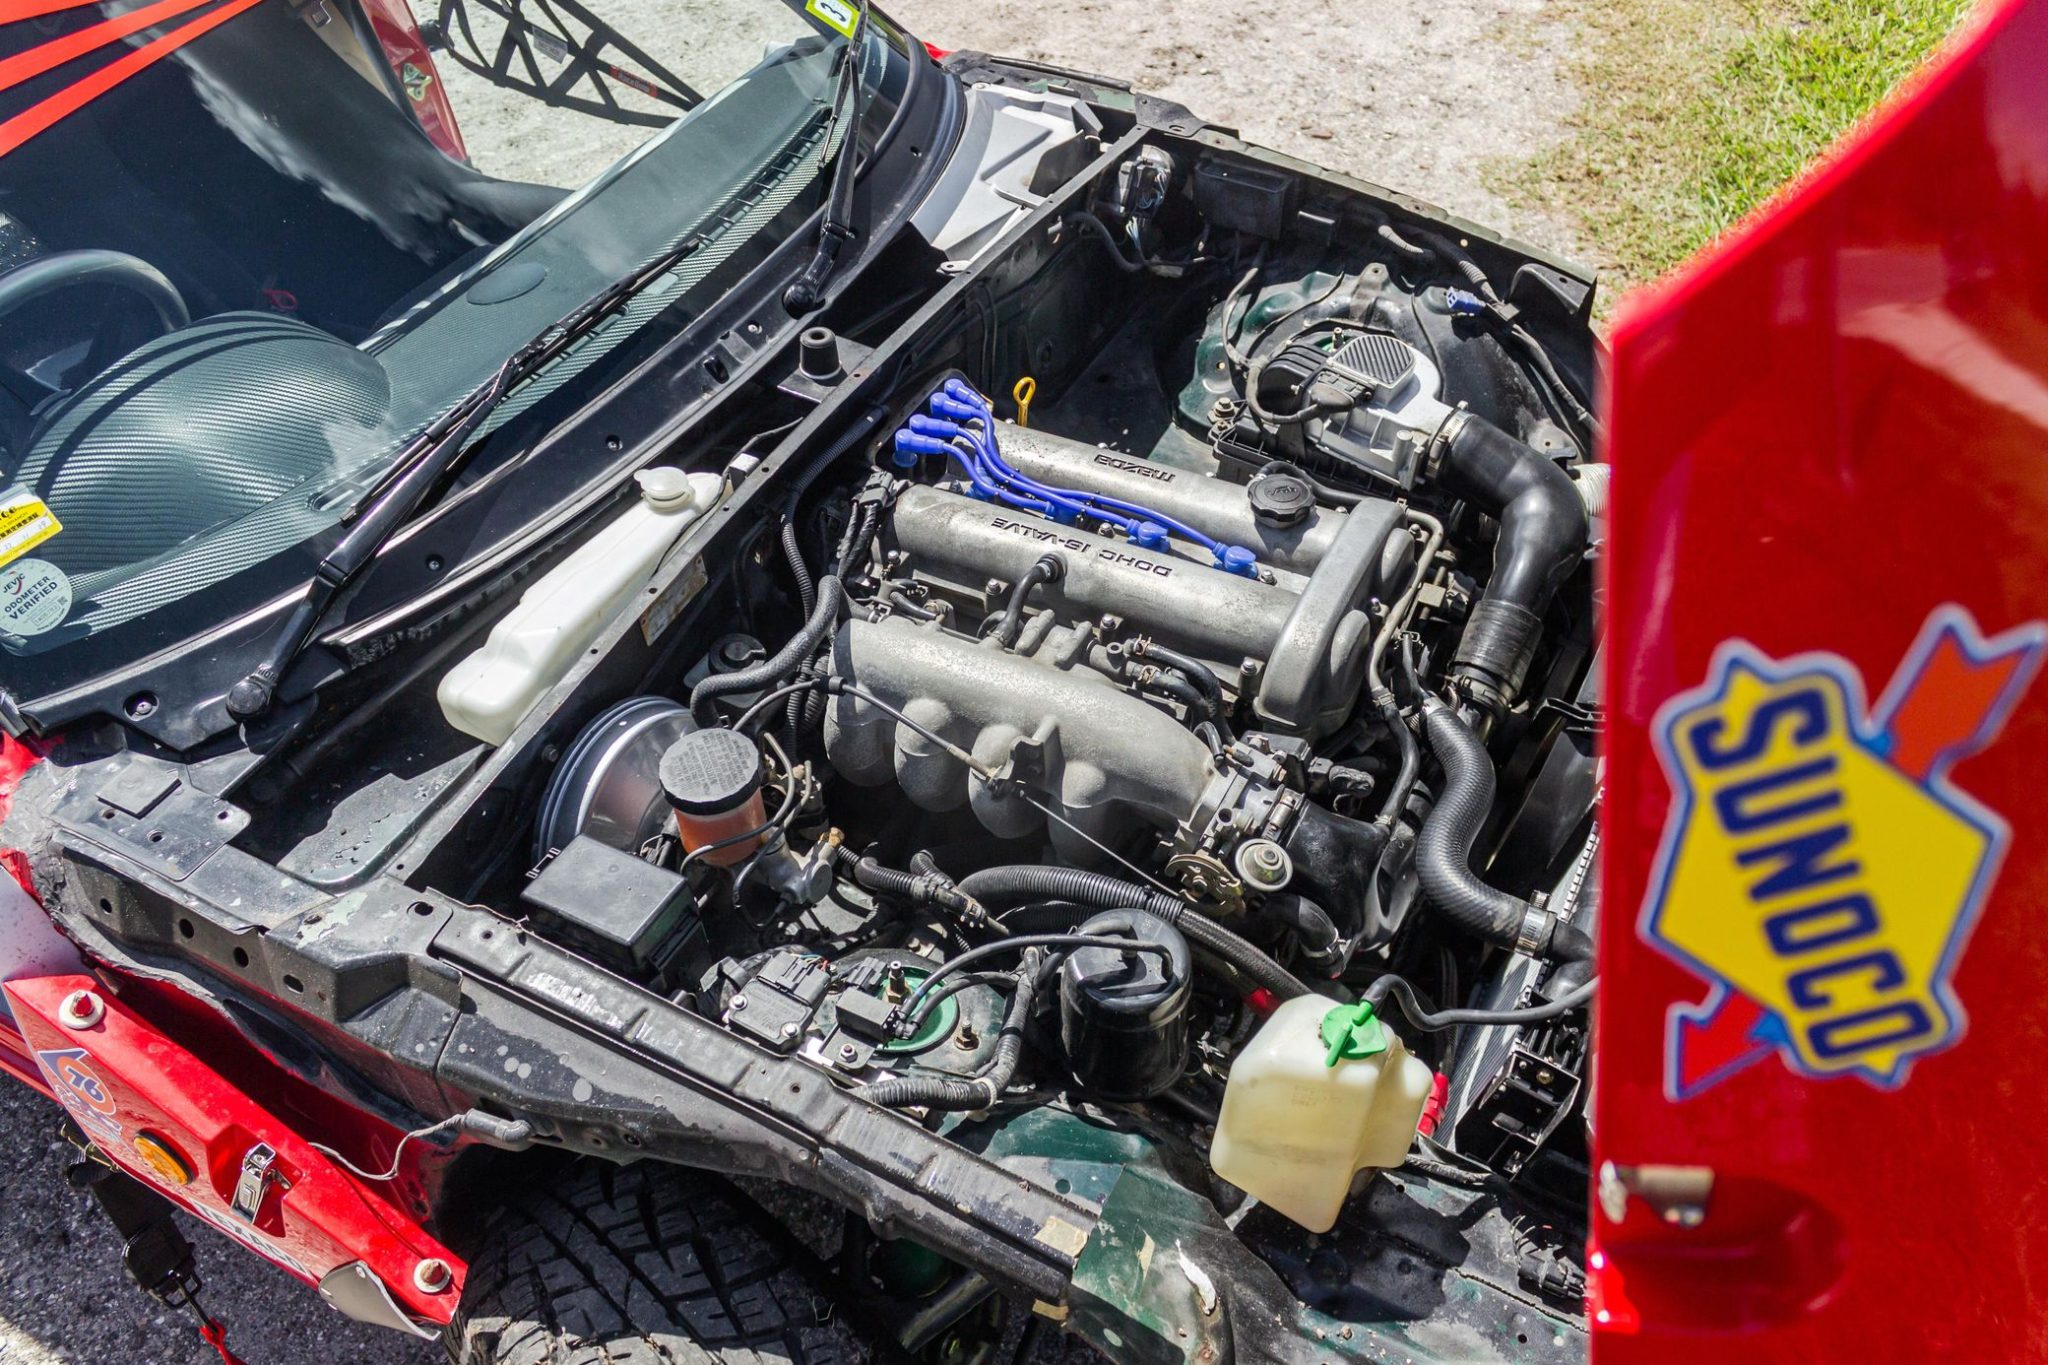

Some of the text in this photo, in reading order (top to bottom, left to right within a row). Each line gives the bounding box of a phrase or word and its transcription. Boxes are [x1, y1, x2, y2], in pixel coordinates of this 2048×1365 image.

[1099, 550, 1173, 578] DOHC
[3, 573, 26, 593] JEVIC
[5, 576, 50, 613] ODOMETER
[9, 581, 58, 620] VERIFIED
[1688, 686, 1933, 1060] SUNOCO
[65, 1065, 106, 1103] 76
